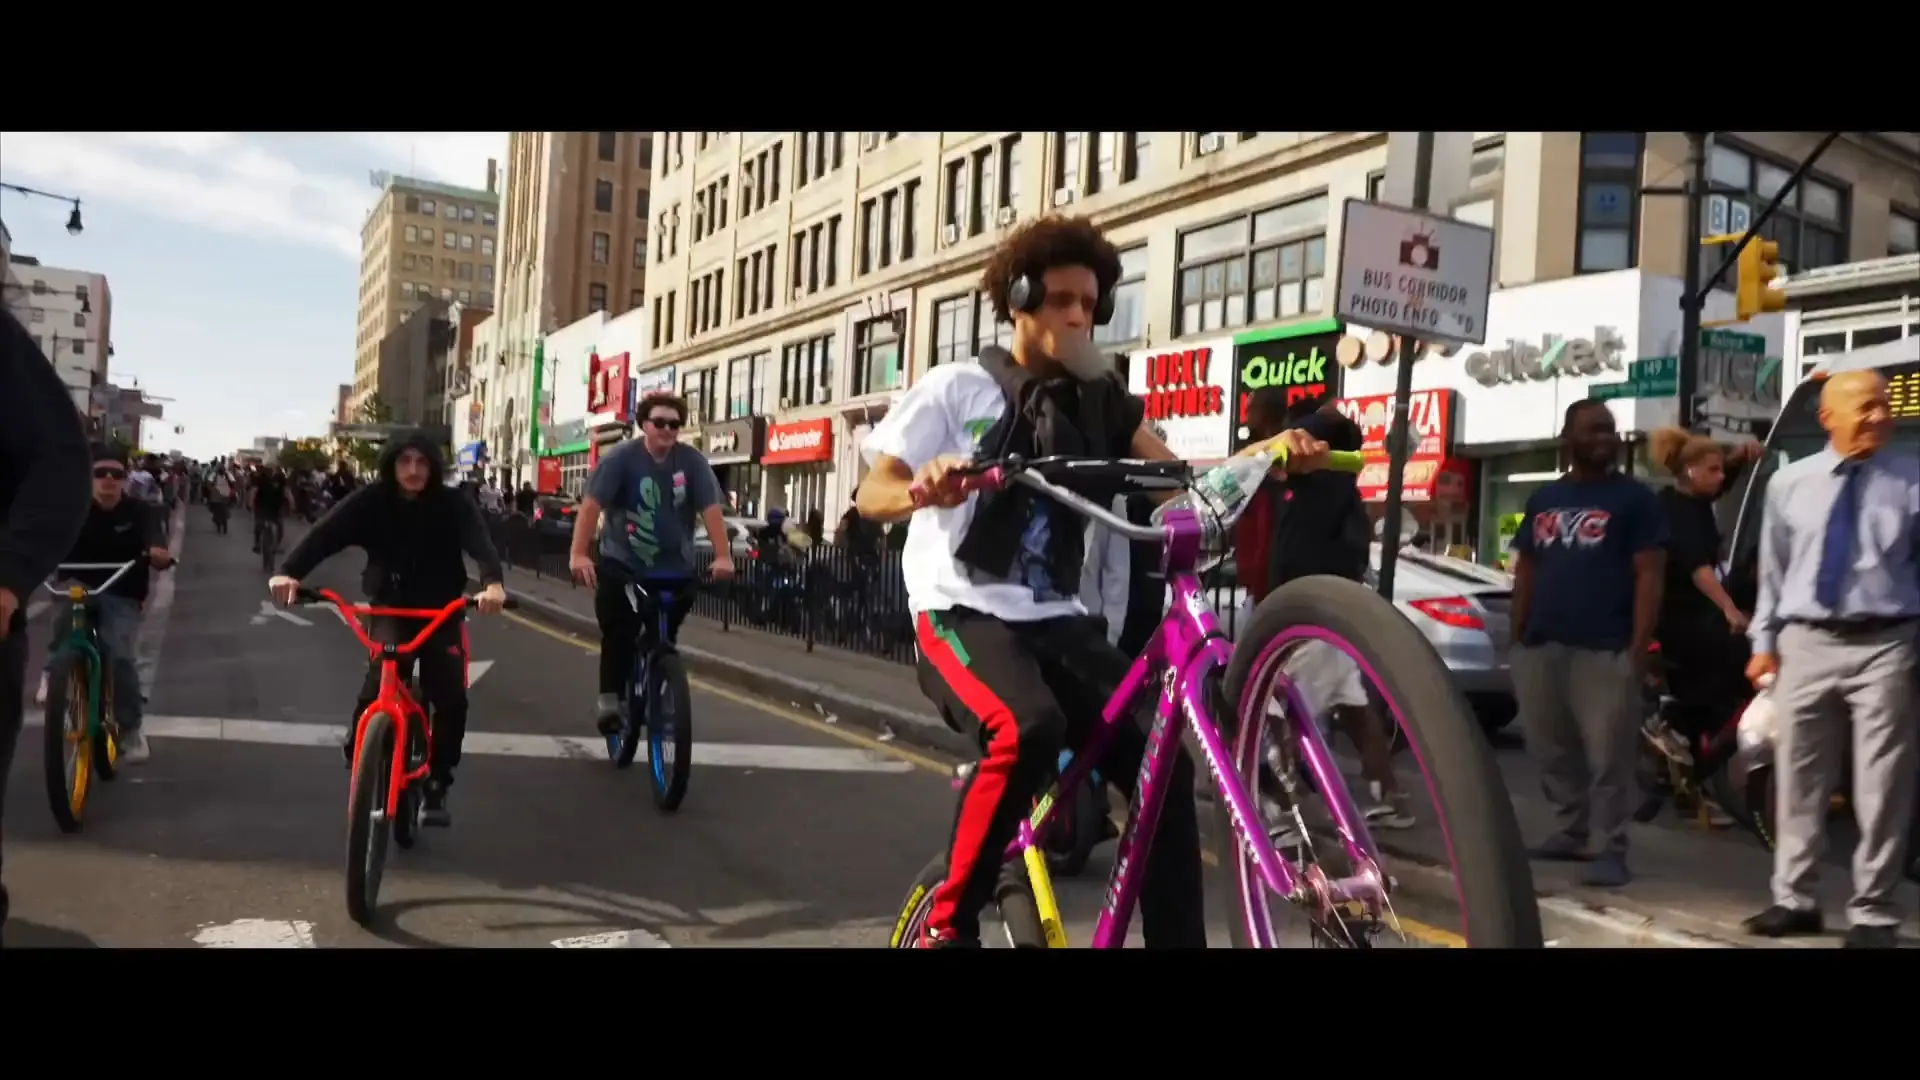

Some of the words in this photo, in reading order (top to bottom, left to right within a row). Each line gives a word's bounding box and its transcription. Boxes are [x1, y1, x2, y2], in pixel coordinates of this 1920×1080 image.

[1363, 268, 1392, 290] BUS
[1399, 275, 1469, 306] CORRIDOR
[1351, 294, 1398, 319] PHOTO
[1403, 303, 1474, 334] ENFOD
[1146, 347, 1213, 389] LUCKY
[1241, 347, 1327, 389] Quick
[779, 427, 823, 451] Santander
[1533, 508, 1610, 548] NYC
